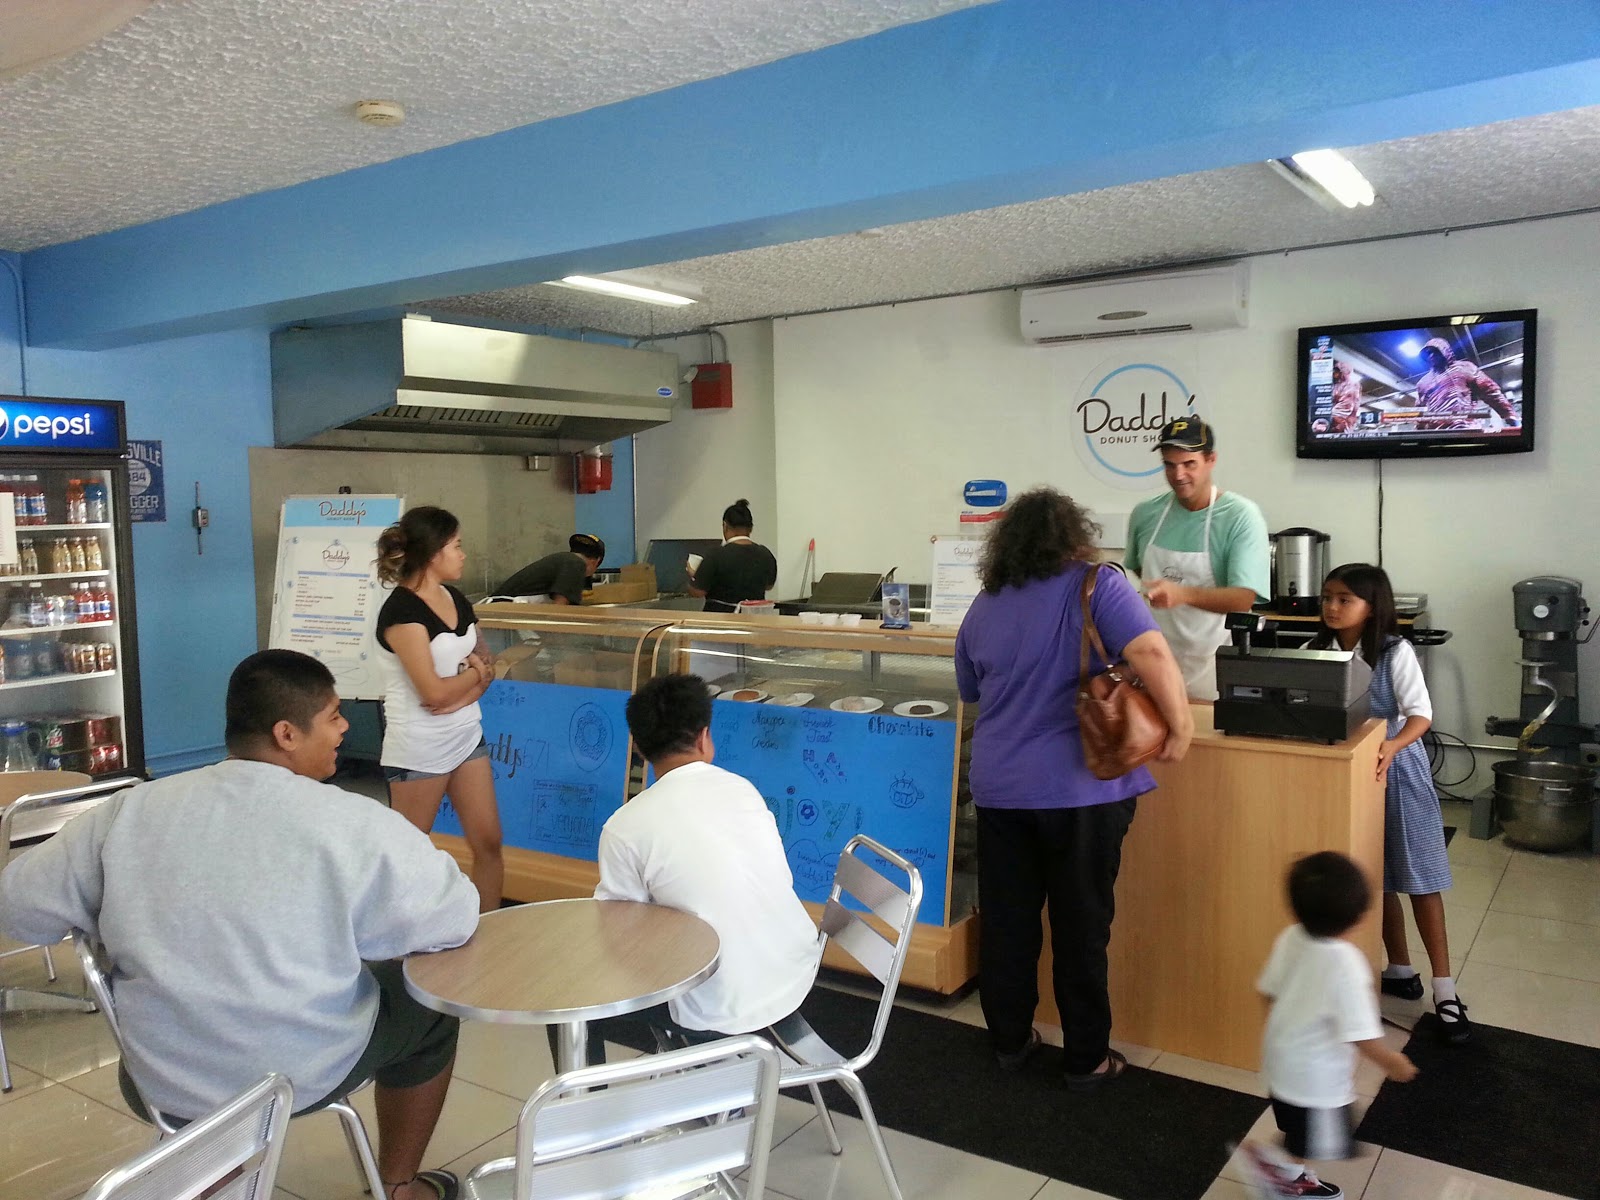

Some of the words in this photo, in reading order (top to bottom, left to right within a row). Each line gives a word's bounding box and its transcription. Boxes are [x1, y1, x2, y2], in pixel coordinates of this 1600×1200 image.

[13, 413, 91, 440] pepsi
[1170, 421, 1190, 435] P
[1100, 435, 1138, 445] DONUT
[1143, 434, 1164, 444] SHO
[130, 495, 159, 509] GGER
[318, 500, 368, 525] Daddy's
[867, 716, 935, 738] Chocolate
